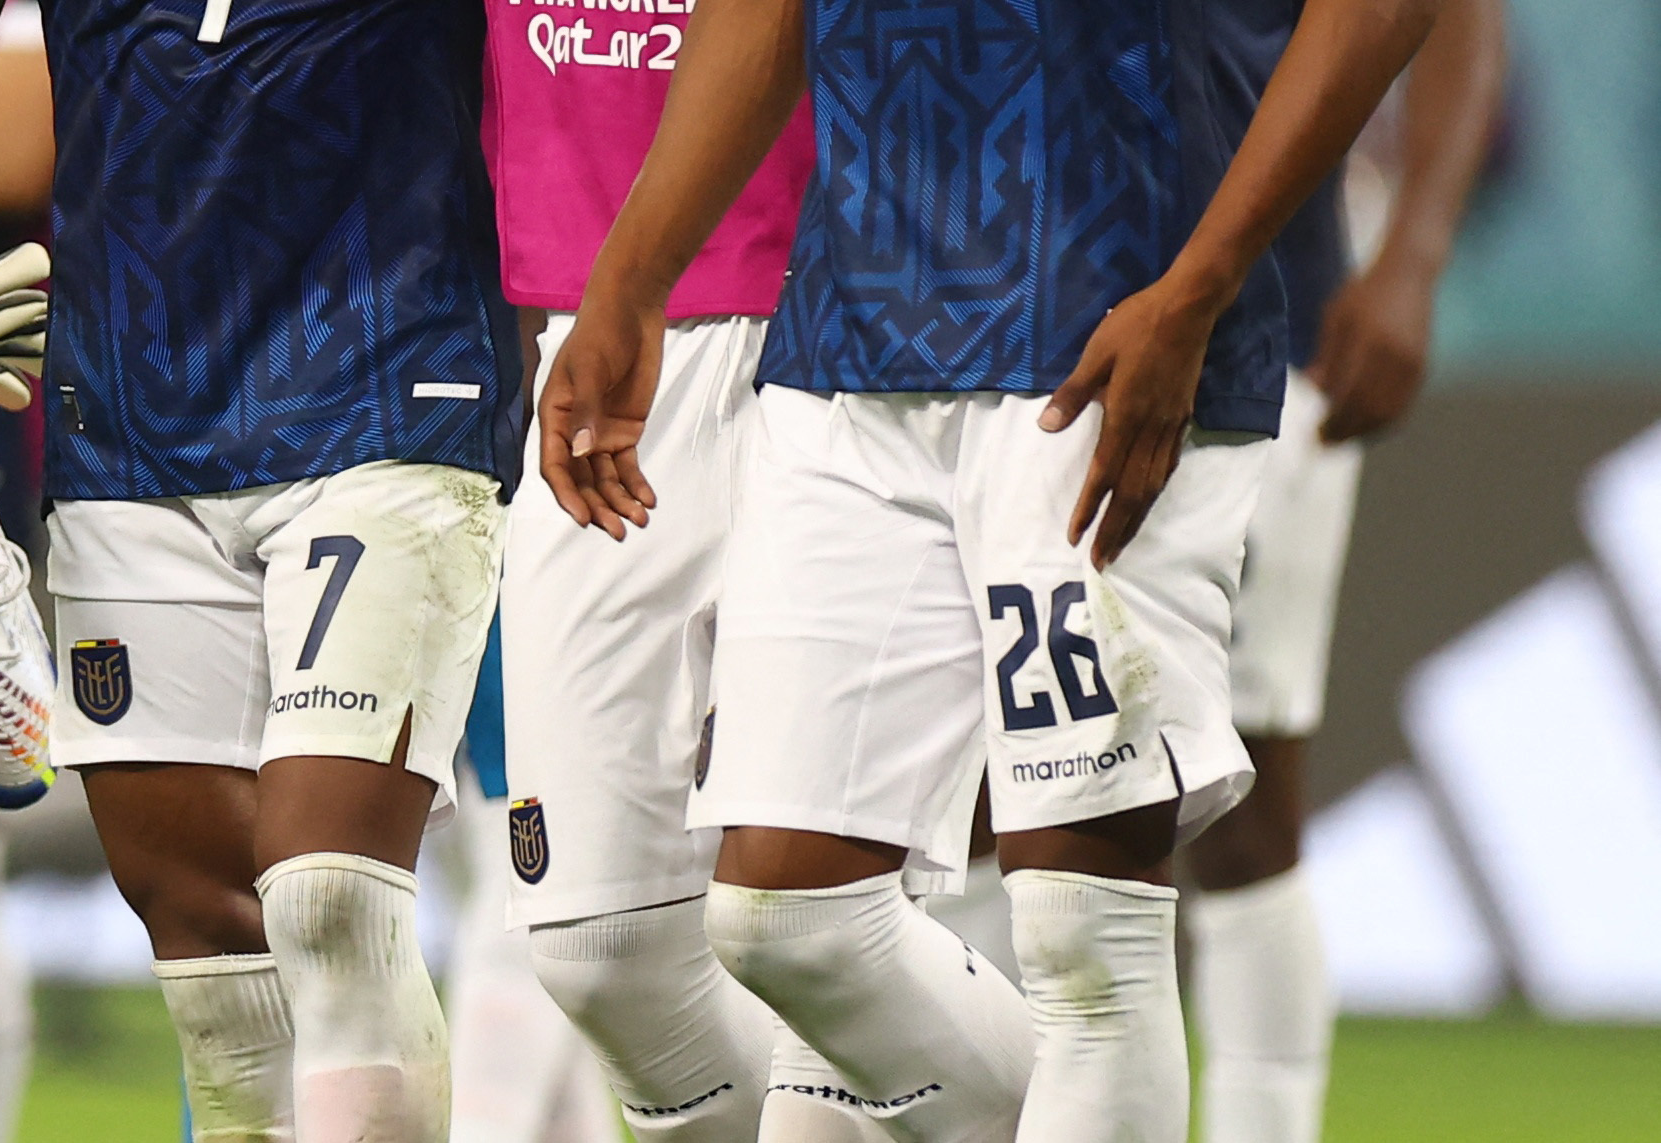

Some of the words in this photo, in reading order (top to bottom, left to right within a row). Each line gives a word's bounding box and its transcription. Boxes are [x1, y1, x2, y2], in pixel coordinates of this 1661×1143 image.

[295, 534, 367, 671] 7
[987, 580, 1120, 732] 26
[1012, 742, 1138, 783] marathon
